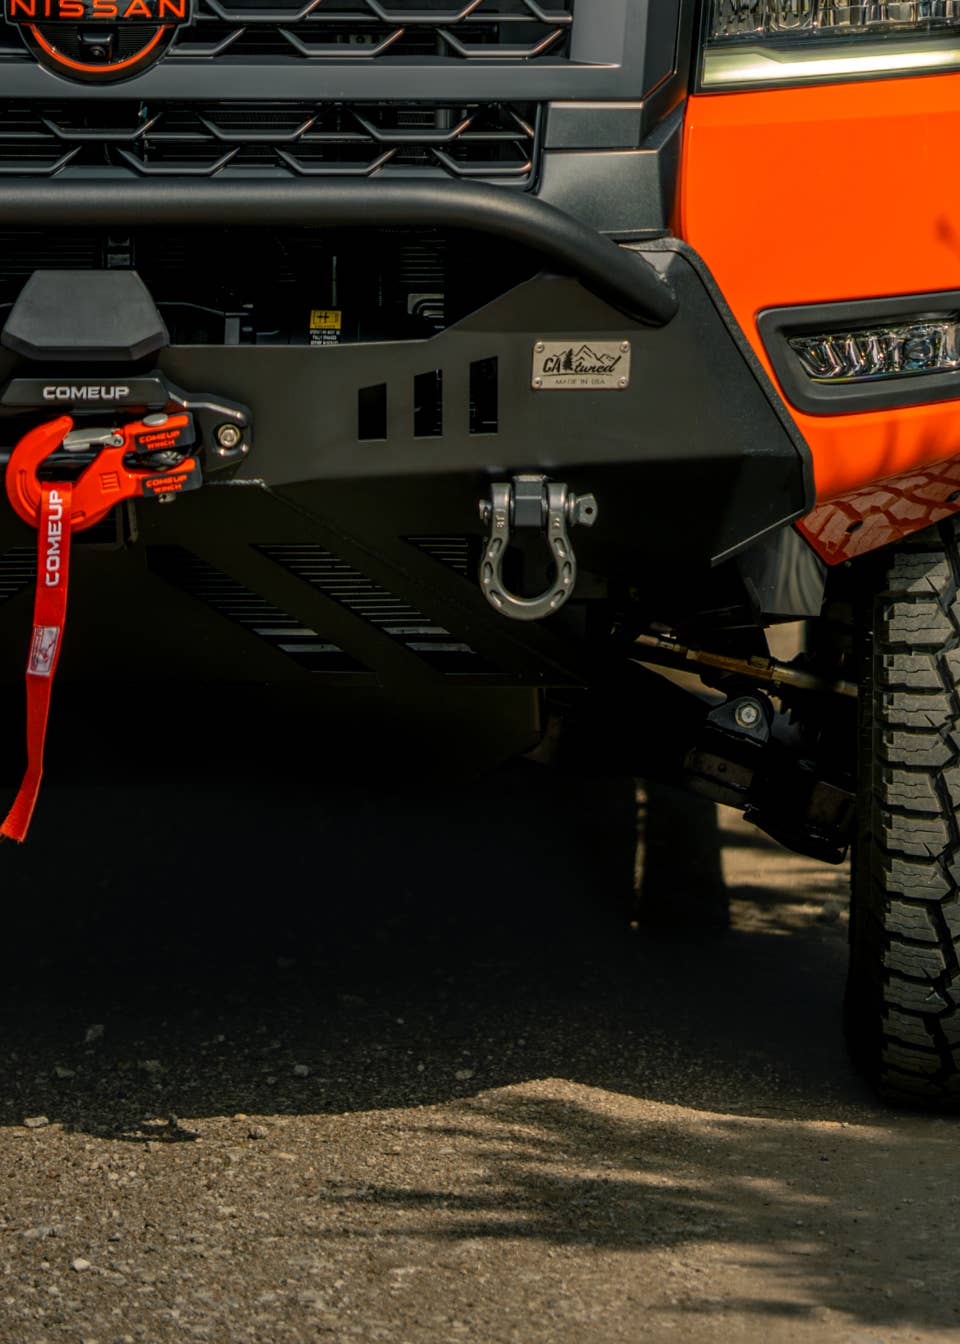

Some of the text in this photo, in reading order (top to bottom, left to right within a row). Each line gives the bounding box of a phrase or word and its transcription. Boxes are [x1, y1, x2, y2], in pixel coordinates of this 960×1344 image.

[543, 357, 560, 373] CA
[43, 385, 130, 400] COMEUP
[139, 430, 180, 444] COMEUP
[146, 439, 176, 449] WINCH
[145, 474, 188, 489] COMEUP
[153, 483, 182, 494] WINCH
[45, 489, 63, 587] COMEUP
